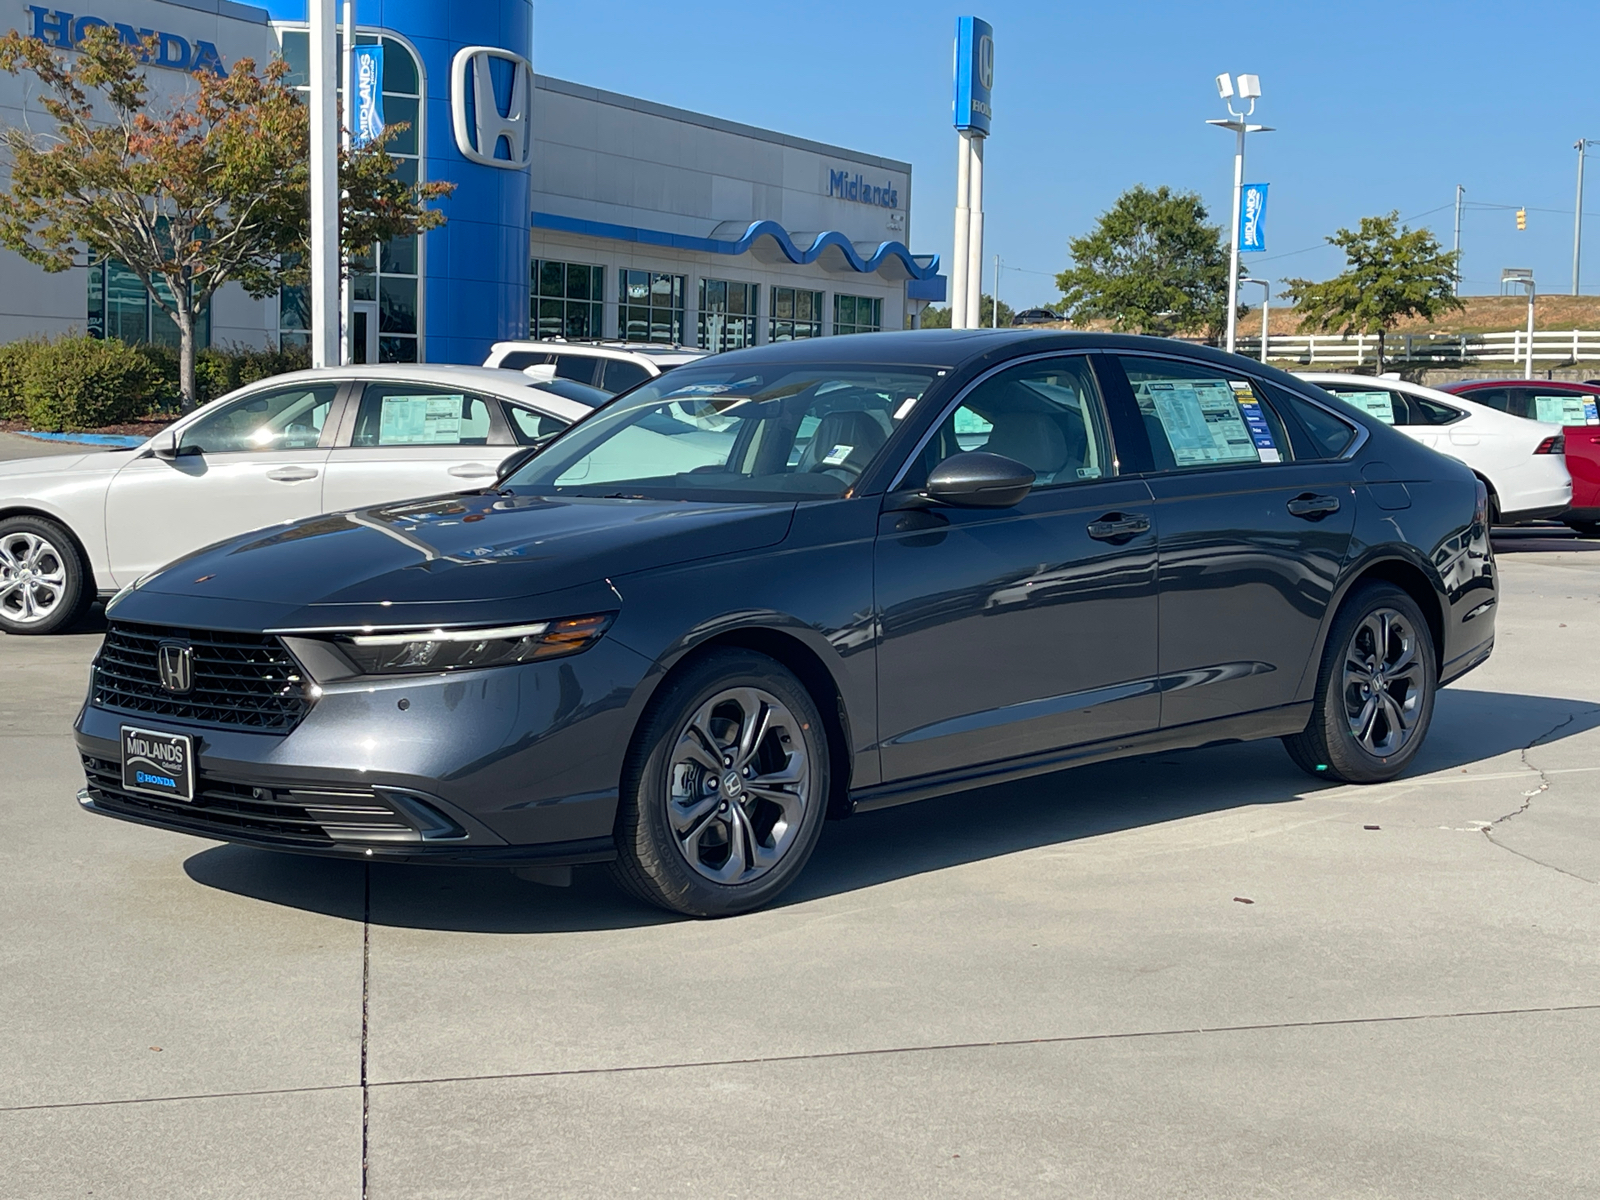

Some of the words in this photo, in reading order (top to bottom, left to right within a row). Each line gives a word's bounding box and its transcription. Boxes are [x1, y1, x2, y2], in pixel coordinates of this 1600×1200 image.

[359, 53, 371, 139] MIDLANDS
[830, 168, 898, 209] Midlands
[1245, 189, 1257, 246] MIDLANDS
[127, 737, 183, 763] MIDLANDS
[145, 774, 176, 788] HONDA
